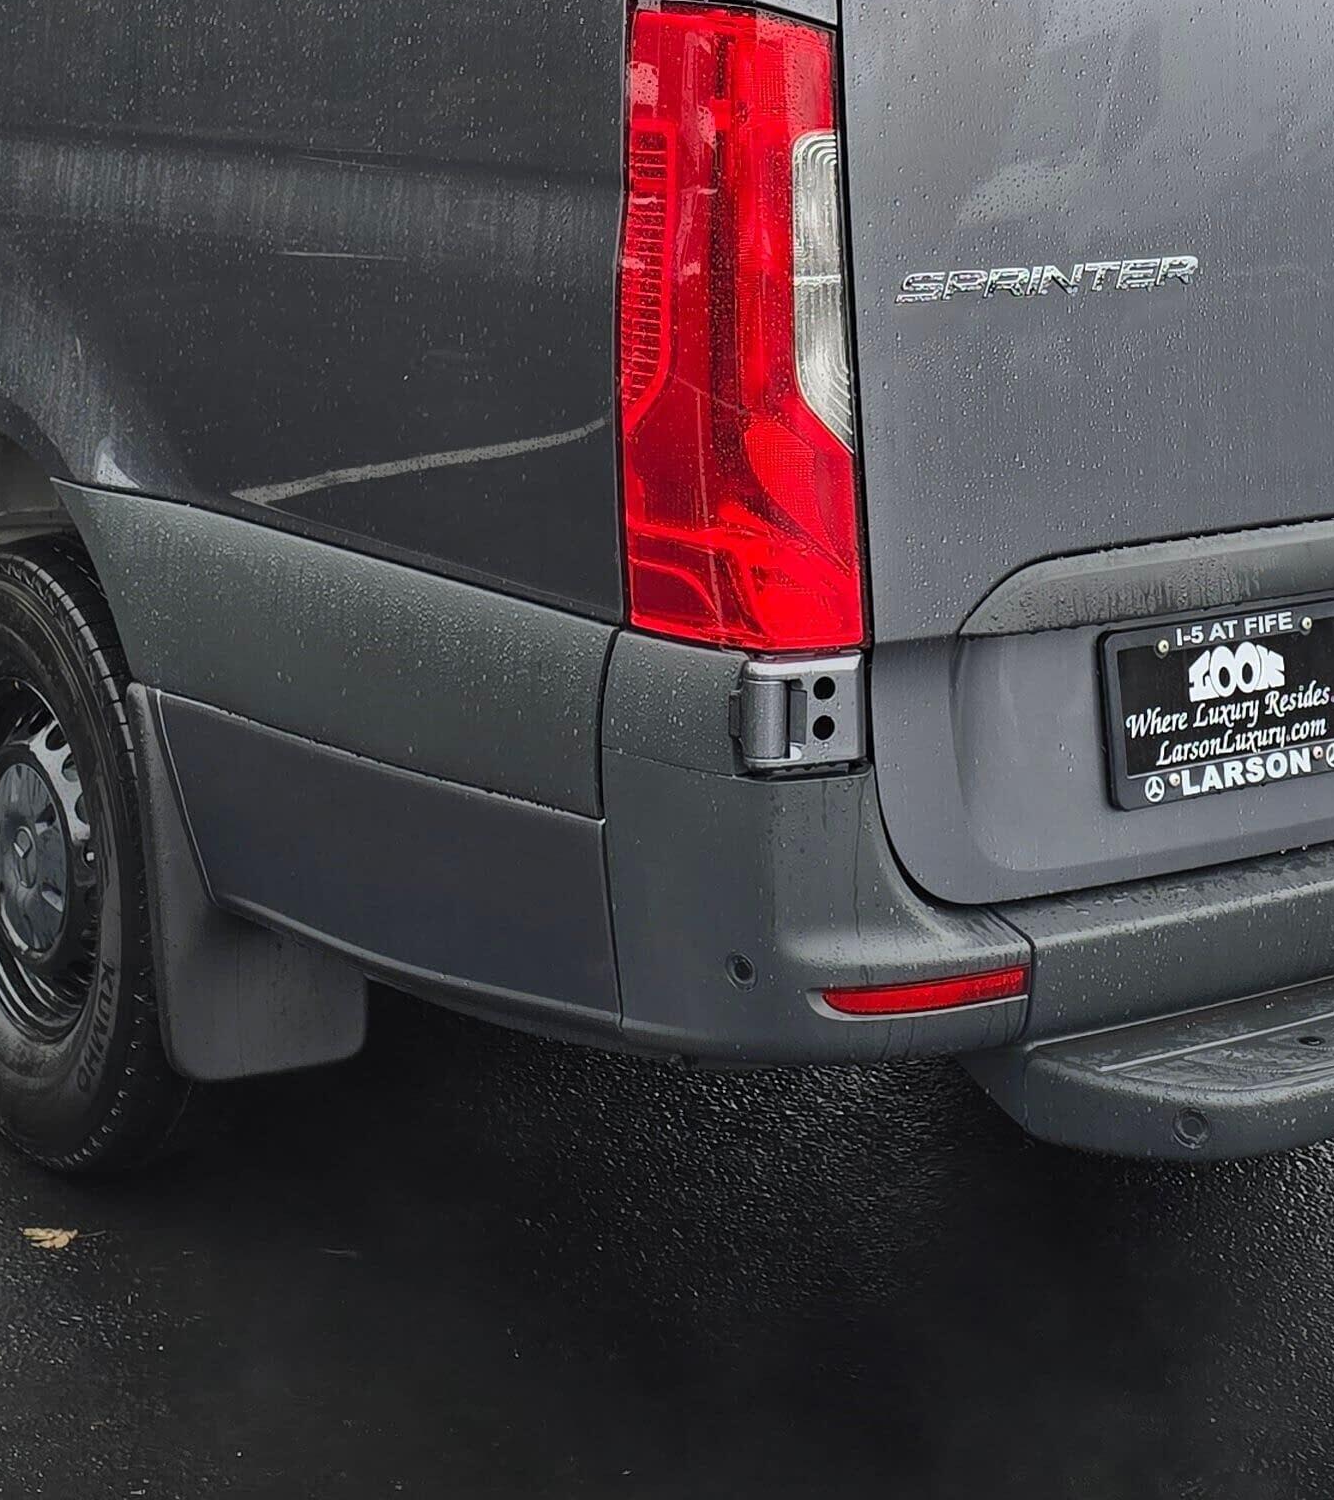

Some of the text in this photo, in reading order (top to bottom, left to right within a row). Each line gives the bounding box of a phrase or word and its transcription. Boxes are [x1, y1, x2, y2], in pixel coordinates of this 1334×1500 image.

[895, 255, 1198, 304] SPRINTER
[1176, 612, 1293, 646] I-5 AT FIFE
[1126, 707, 1188, 739] Where
[1193, 702, 1259, 728] Luxury
[1156, 718, 1327, 766] LarsonLuxury.com
[1181, 748, 1311, 796] LARSON
[77, 960, 115, 1092] KUMHO
